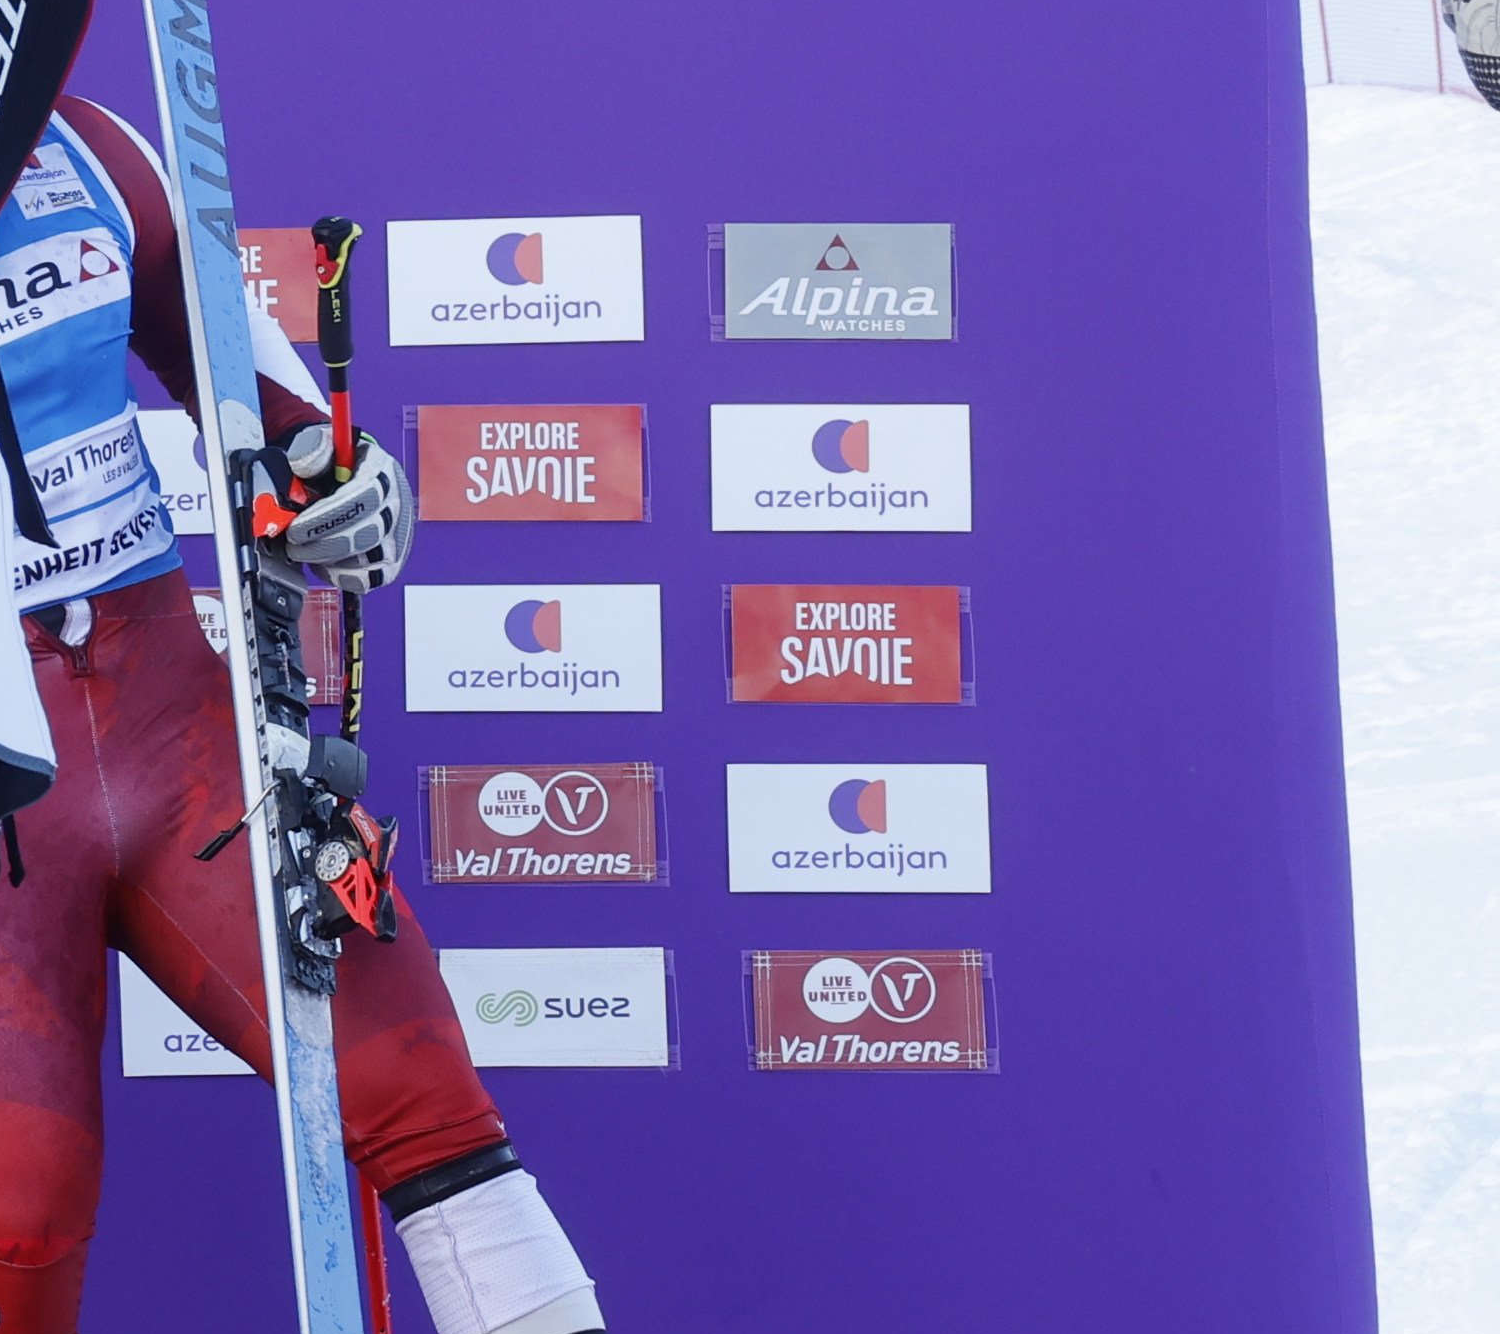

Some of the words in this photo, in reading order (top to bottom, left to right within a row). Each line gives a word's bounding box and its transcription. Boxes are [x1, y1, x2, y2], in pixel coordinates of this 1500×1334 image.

[330, 288, 342, 324] LEKI
[430, 295, 603, 327] azerbaijan
[740, 276, 940, 326] Alpina
[819, 319, 907, 332] WATCHES
[480, 421, 580, 451] EXPLORE
[465, 454, 596, 505] SAVOIE
[754, 481, 930, 515] azerbaijan
[305, 498, 367, 541] reusch
[795, 601, 897, 633] EXPLORE
[780, 636, 914, 687] SAVOIE
[348, 629, 365, 733] LEKI
[448, 662, 621, 694] azerbaijan
[482, 802, 542, 818] UNITED
[496, 789, 528, 802] LIVE
[455, 847, 503, 876] Val
[505, 846, 631, 877] Thorens
[771, 841, 948, 875] azerbaijan
[808, 988, 868, 1004] UNITED
[821, 975, 854, 989] LIVE
[544, 995, 631, 1019] suez
[779, 1034, 829, 1064] Val
[830, 1033, 960, 1064] Thorens
